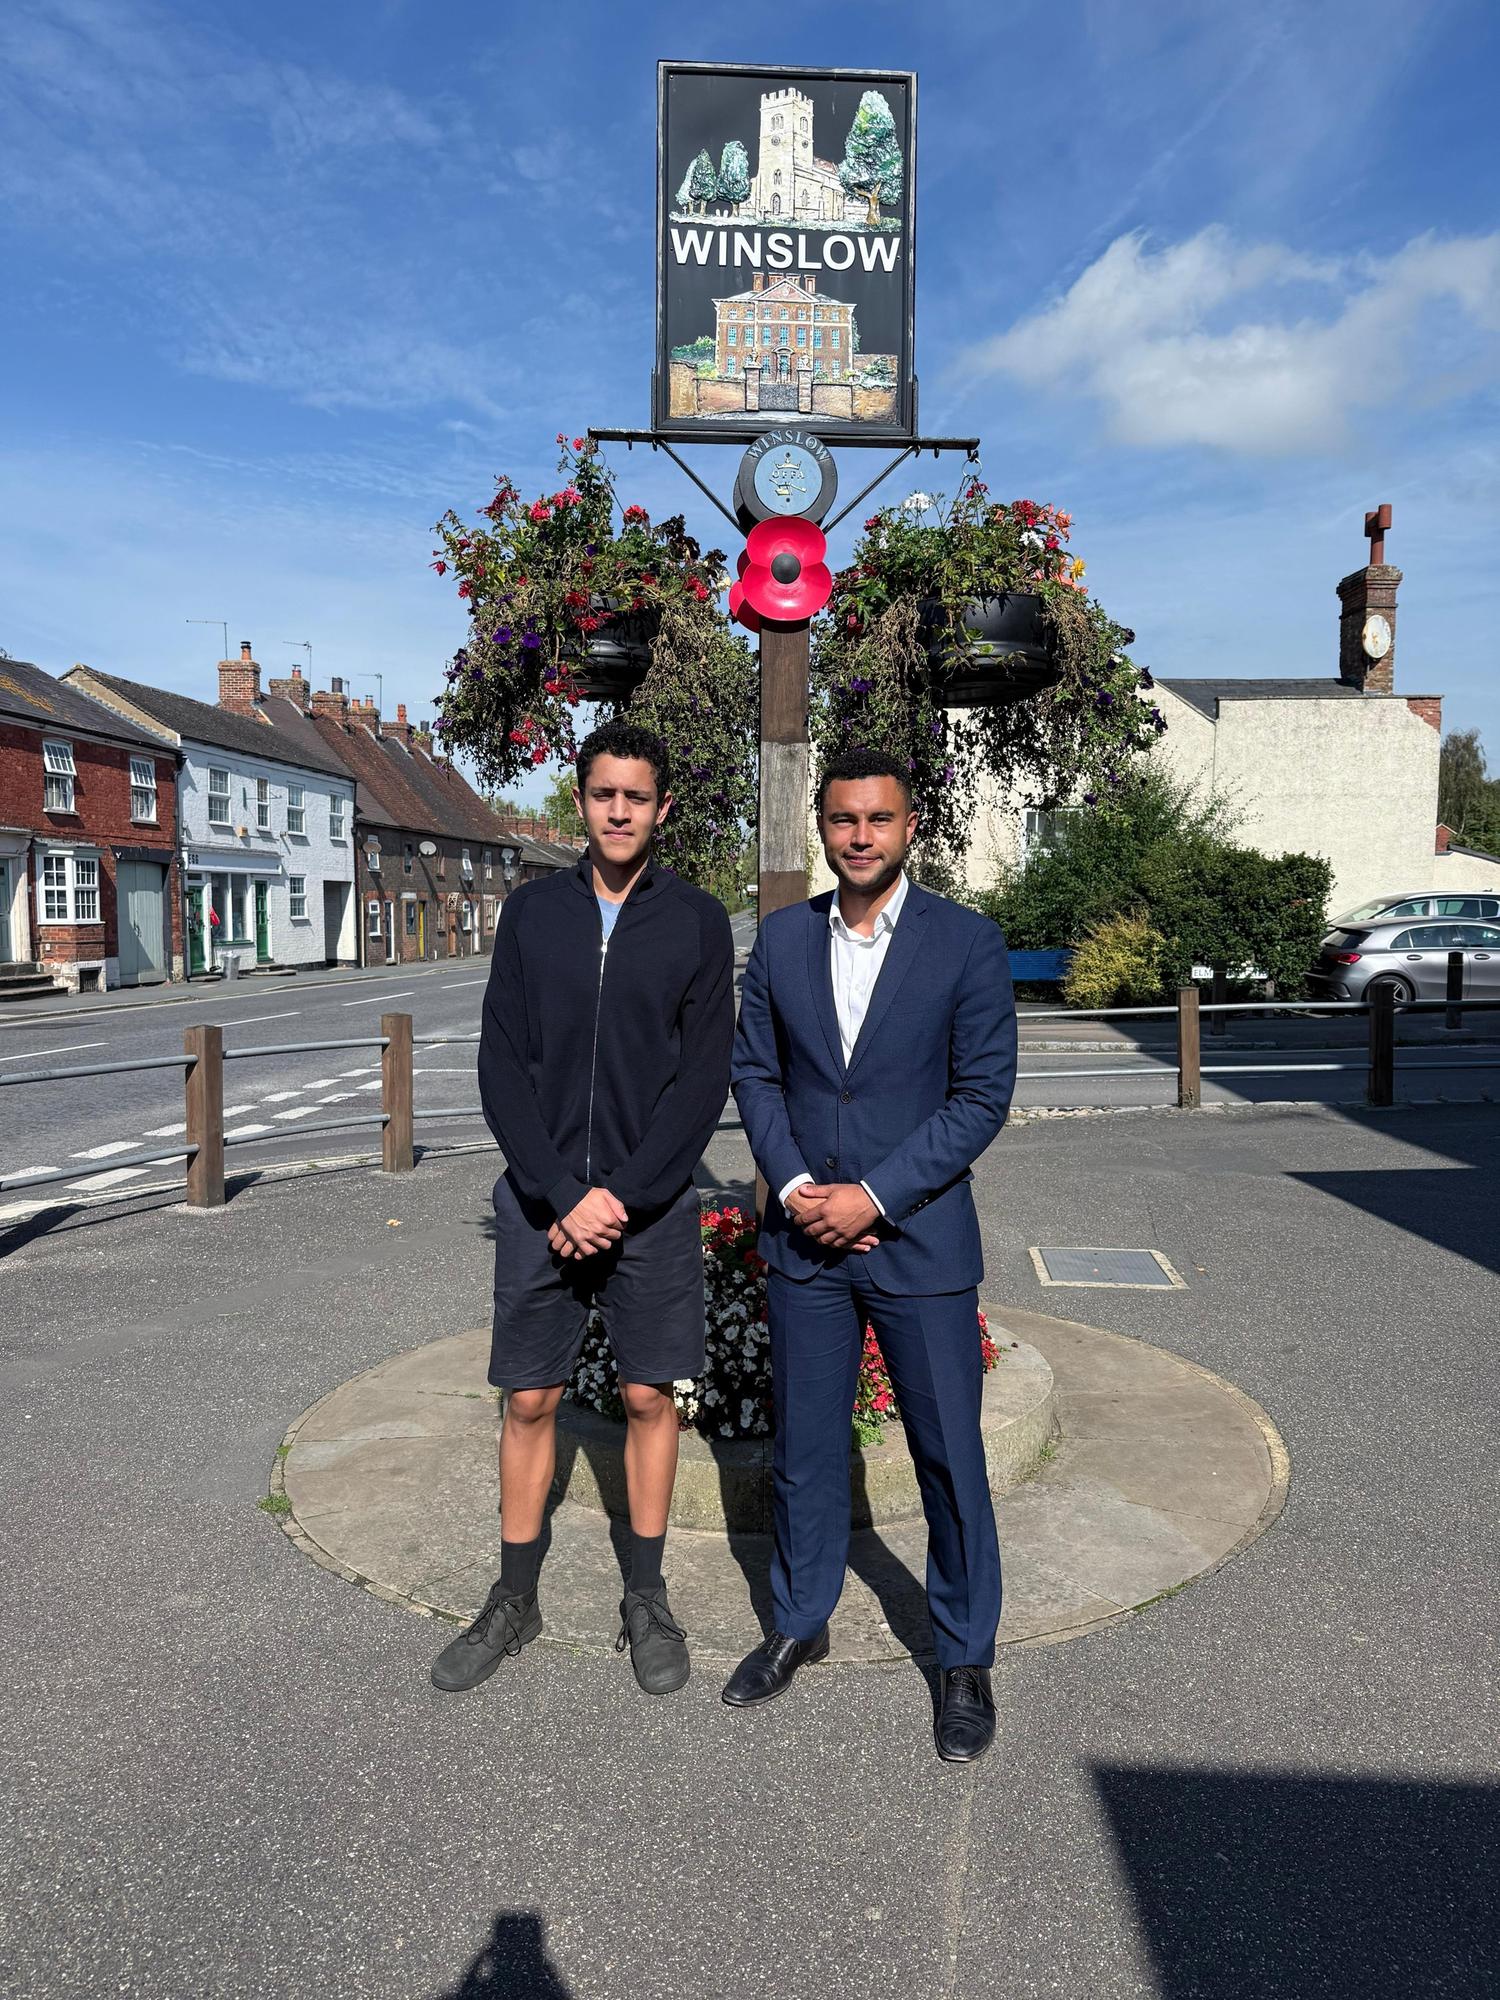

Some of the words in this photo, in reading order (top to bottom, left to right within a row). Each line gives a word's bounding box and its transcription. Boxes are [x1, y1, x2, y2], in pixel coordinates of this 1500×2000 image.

[670, 229, 900, 272] WINSLOW
[747, 429, 830, 461] WINSLOW
[771, 470, 805, 480] OFFA
